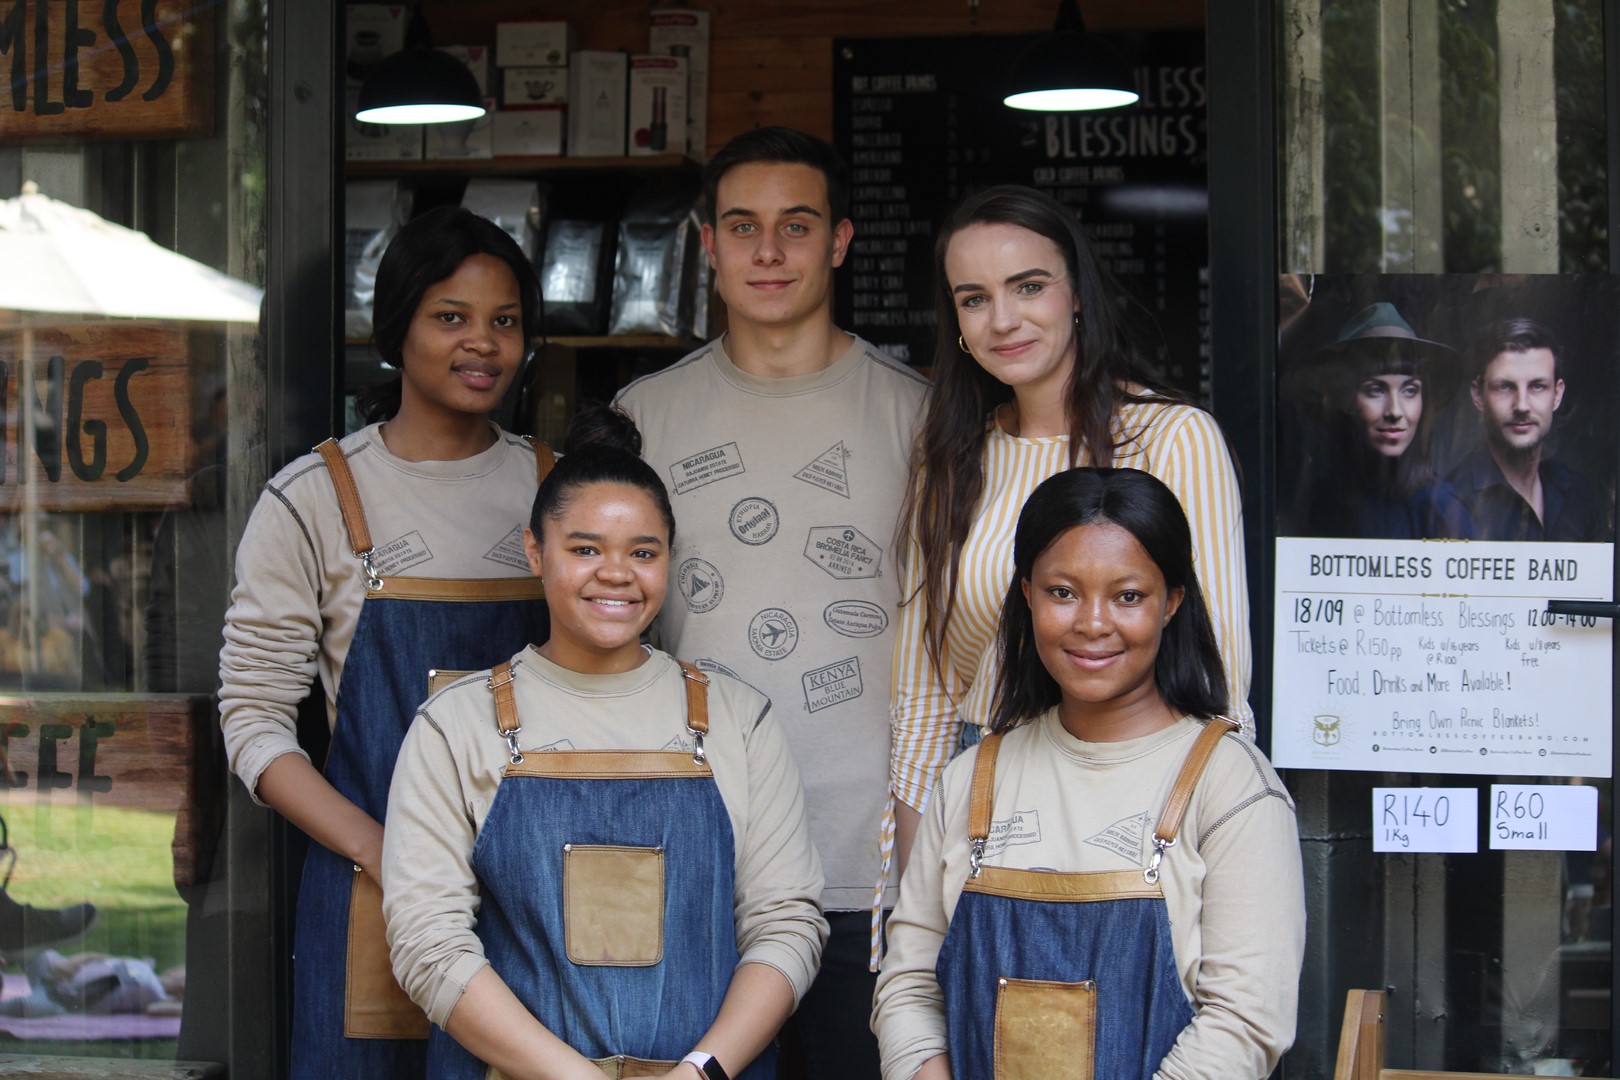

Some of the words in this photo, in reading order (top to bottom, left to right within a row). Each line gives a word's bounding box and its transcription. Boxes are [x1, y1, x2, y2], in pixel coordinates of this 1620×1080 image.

[1044, 114, 1198, 159] BLESSINGS
[682, 450, 726, 470] NICARAGUA
[738, 508, 771, 534] Original
[370, 540, 410, 560] CARAGUA
[816, 541, 849, 557] BROMELIA
[827, 537, 849, 549] COSTA
[851, 544, 866, 555] RICA
[828, 561, 851, 574] ARRIVED
[1310, 554, 1432, 578] BOTTOMLESS
[1446, 557, 1515, 581] COFFEE
[1528, 559, 1578, 581] BAND
[760, 612, 795, 638] NICARAGUA
[1294, 598, 1343, 626] 18/09
[1354, 604, 1365, 624] @
[1374, 598, 1444, 627] Bottomless
[1459, 601, 1515, 635] Blessings
[765, 647, 787, 656] ESTATE
[1419, 637, 1435, 650] Kids
[1505, 637, 1520, 650] Kids
[1521, 652, 1540, 667] free
[810, 664, 856, 687] KENYA
[1373, 669, 1407, 695] Drinks
[1410, 679, 1423, 692] and
[1427, 672, 1450, 692] More
[1461, 669, 1511, 692] Available!
[811, 686, 860, 709] MOUNTAIN
[824, 681, 847, 694] BLUE
[1392, 711, 1421, 732] Bring
[1429, 710, 1452, 729] Own
[1460, 707, 1484, 728] Picnic
[1492, 707, 1539, 729] Blankets!
[1383, 793, 1450, 828] R140
[1496, 790, 1544, 819] R60
[1496, 821, 1548, 840] Small
